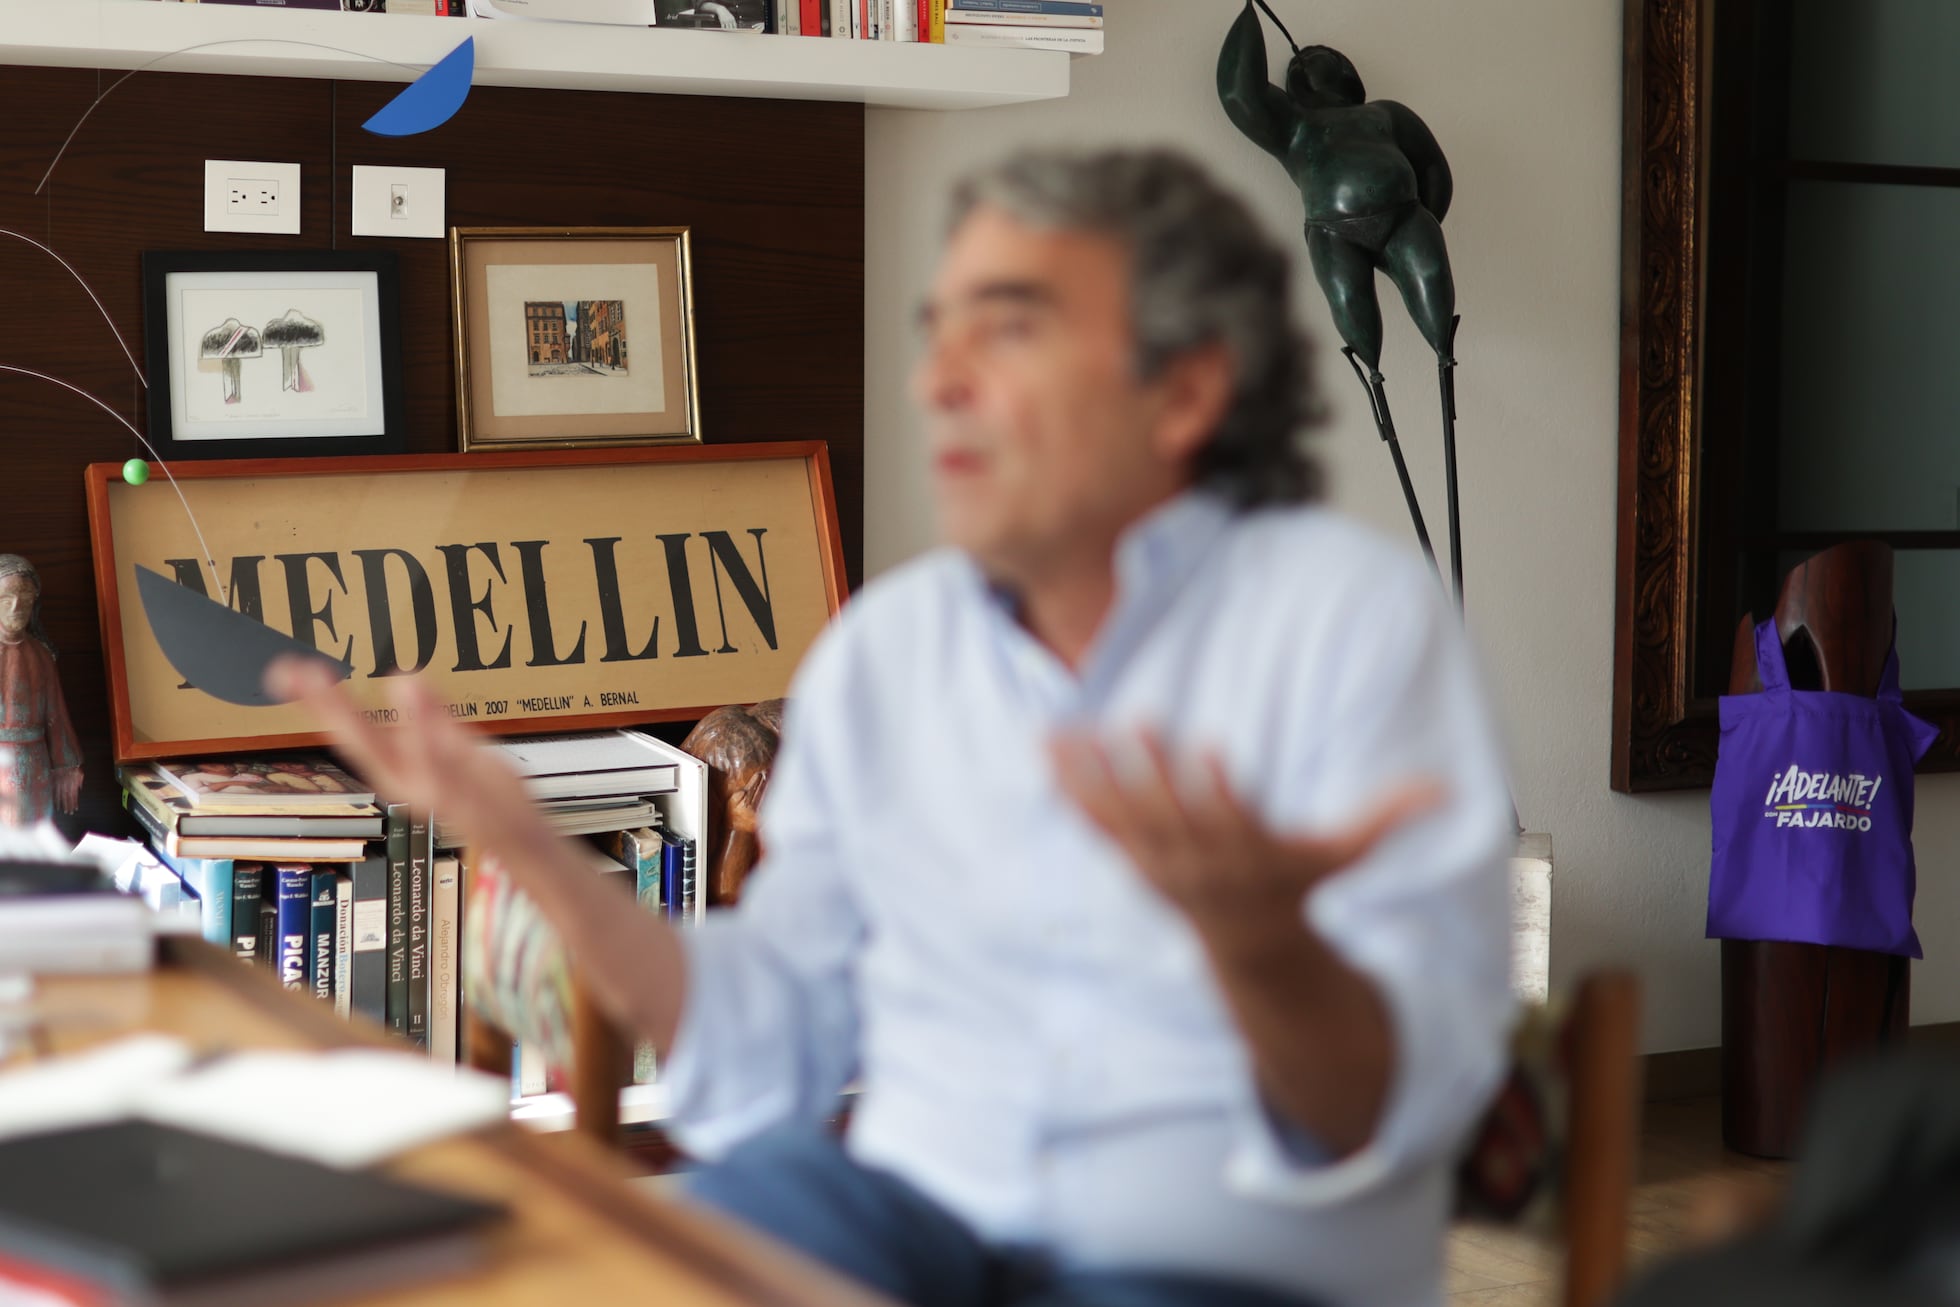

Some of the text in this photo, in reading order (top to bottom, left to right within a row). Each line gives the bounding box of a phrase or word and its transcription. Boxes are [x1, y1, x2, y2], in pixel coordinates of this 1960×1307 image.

[484, 700, 509, 715] 2007
[583, 696, 594, 708] A.
[599, 690, 640, 707] BERNAL
[1764, 764, 1882, 810] ¡ADELANTE!
[1776, 811, 1872, 832] FAJARDO
[338, 899, 350, 954] Donación
[392, 861, 405, 984] Leonardo da Vinci
[411, 858, 425, 980] Leonardo da Vinci
[440, 919, 450, 970] Alejandro
[282, 934, 304, 993] PICAS
[316, 933, 330, 999] MANZUR
